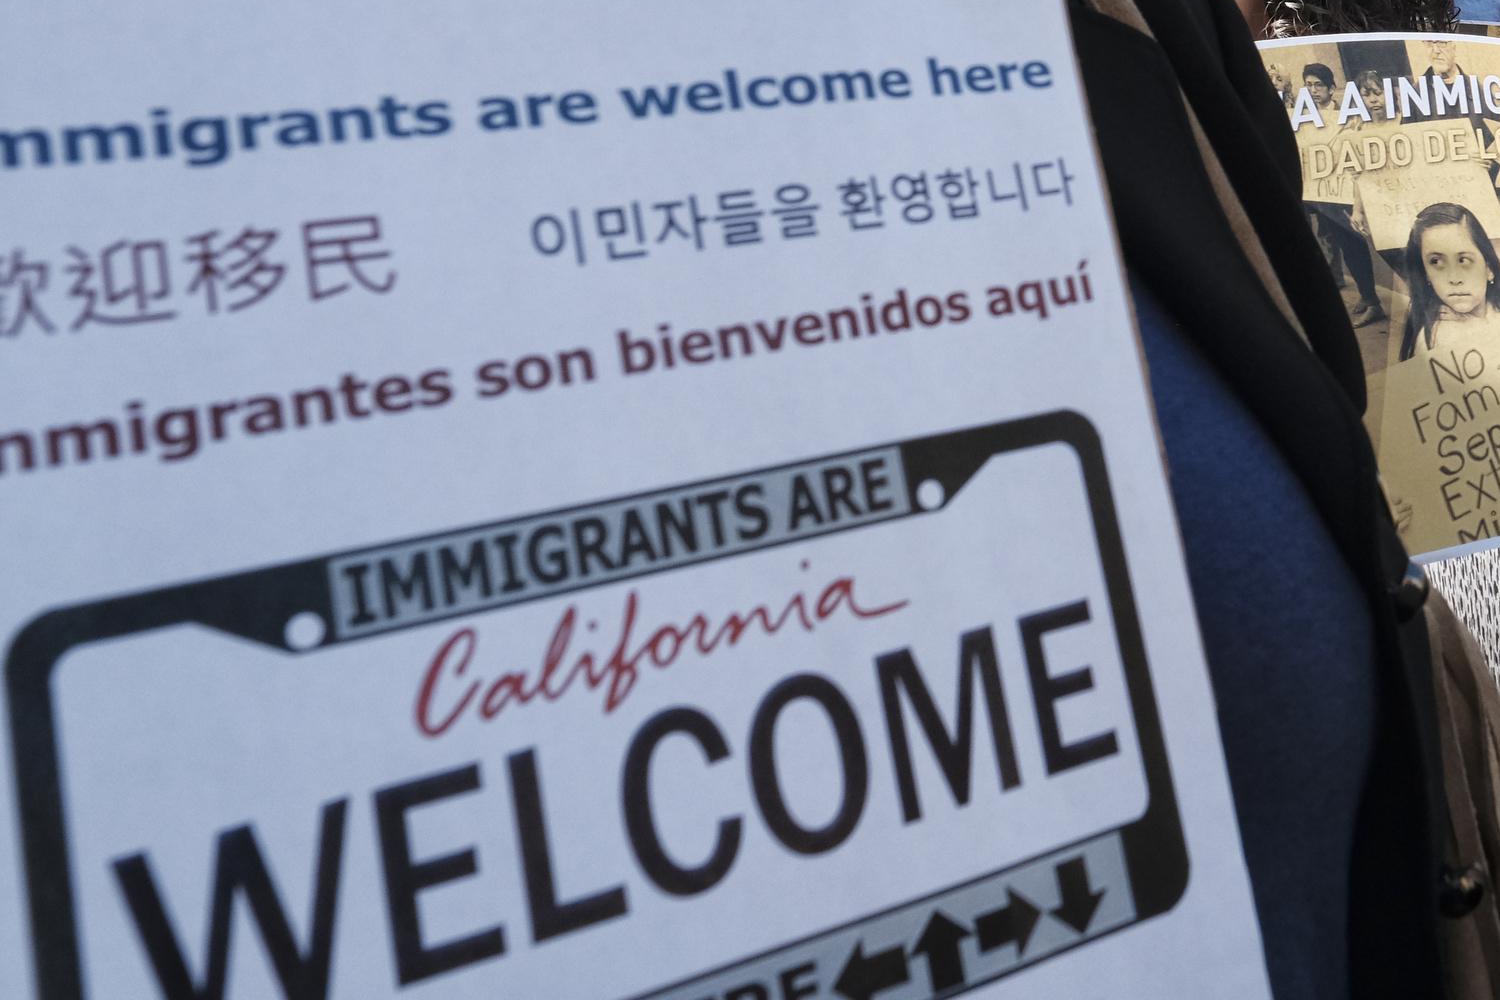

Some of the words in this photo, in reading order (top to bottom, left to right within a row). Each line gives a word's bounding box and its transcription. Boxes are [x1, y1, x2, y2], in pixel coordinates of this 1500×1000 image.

[477, 81, 600, 133] are
[619, 57, 912, 119] welcome
[926, 48, 1053, 97] here
[1336, 80, 1372, 125] A
[1423, 128, 1470, 164] DE
[529, 180, 823, 268] 이민자들을
[836, 156, 1076, 235] 환영합니다
[476, 340, 596, 399] son
[617, 284, 972, 377] bienvenidos
[986, 261, 1096, 322] aquí
[1428, 349, 1485, 395] No
[344, 478, 770, 627] IMMIGRANTS
[787, 456, 896, 532] ARE
[414, 559, 908, 739] California
[109, 598, 1120, 1000] WELCOME
